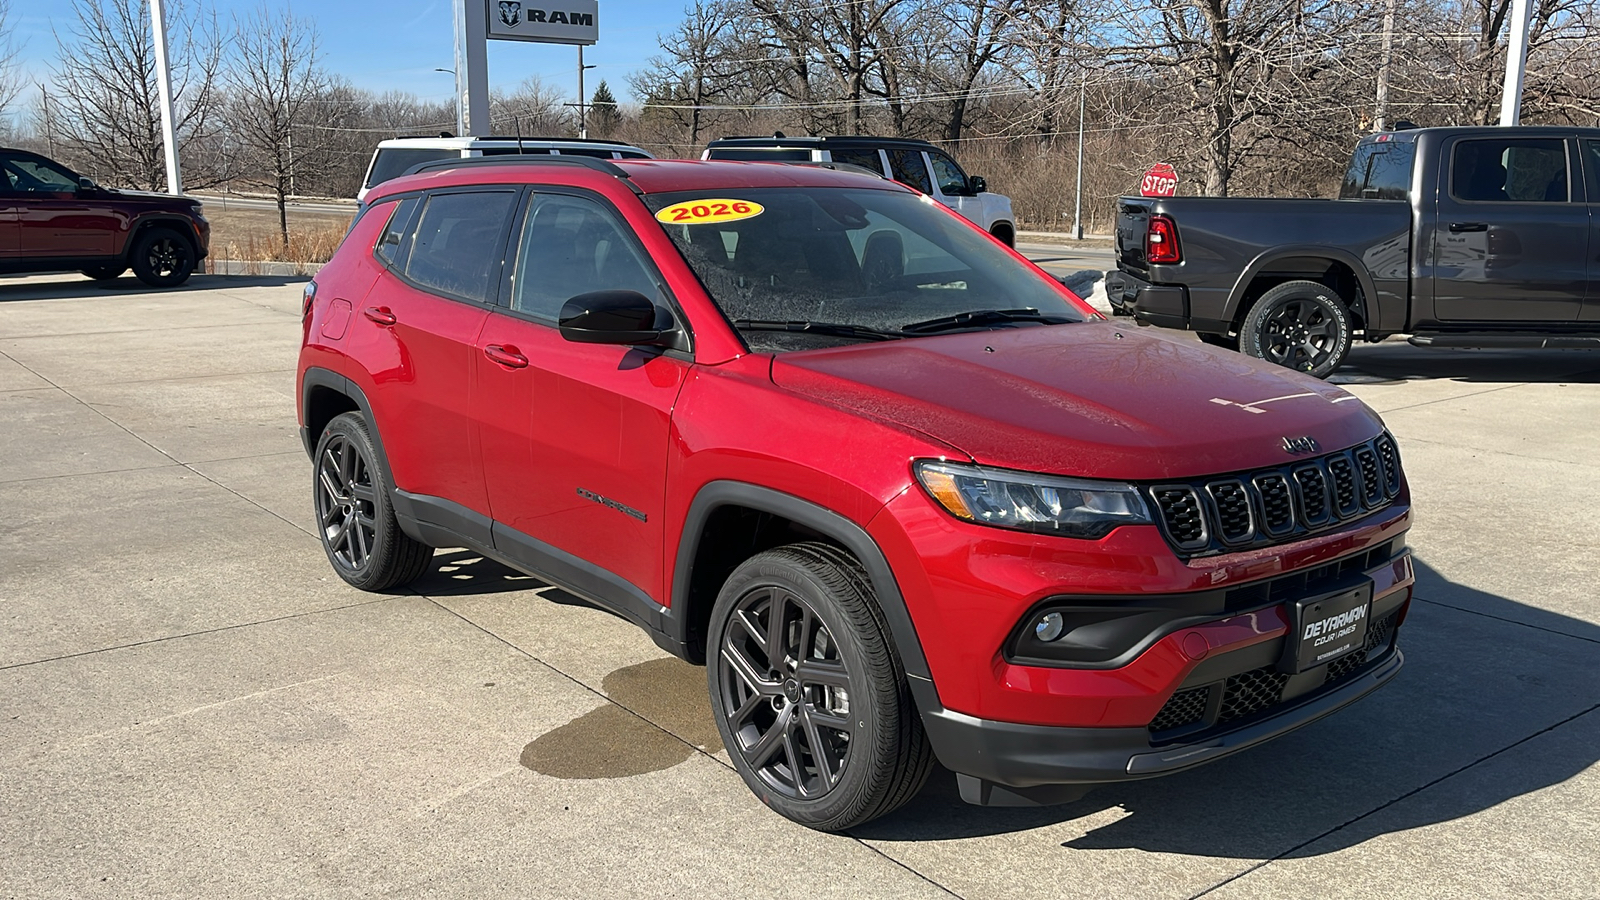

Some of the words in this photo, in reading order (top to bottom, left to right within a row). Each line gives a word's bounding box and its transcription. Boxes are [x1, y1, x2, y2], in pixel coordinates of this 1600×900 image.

[527, 9, 592, 26] RAM
[1143, 175, 1175, 194] STOP
[670, 202, 751, 221] 2026
[1303, 603, 1368, 640] DEYARMAN
[1337, 623, 1357, 639] AMES
